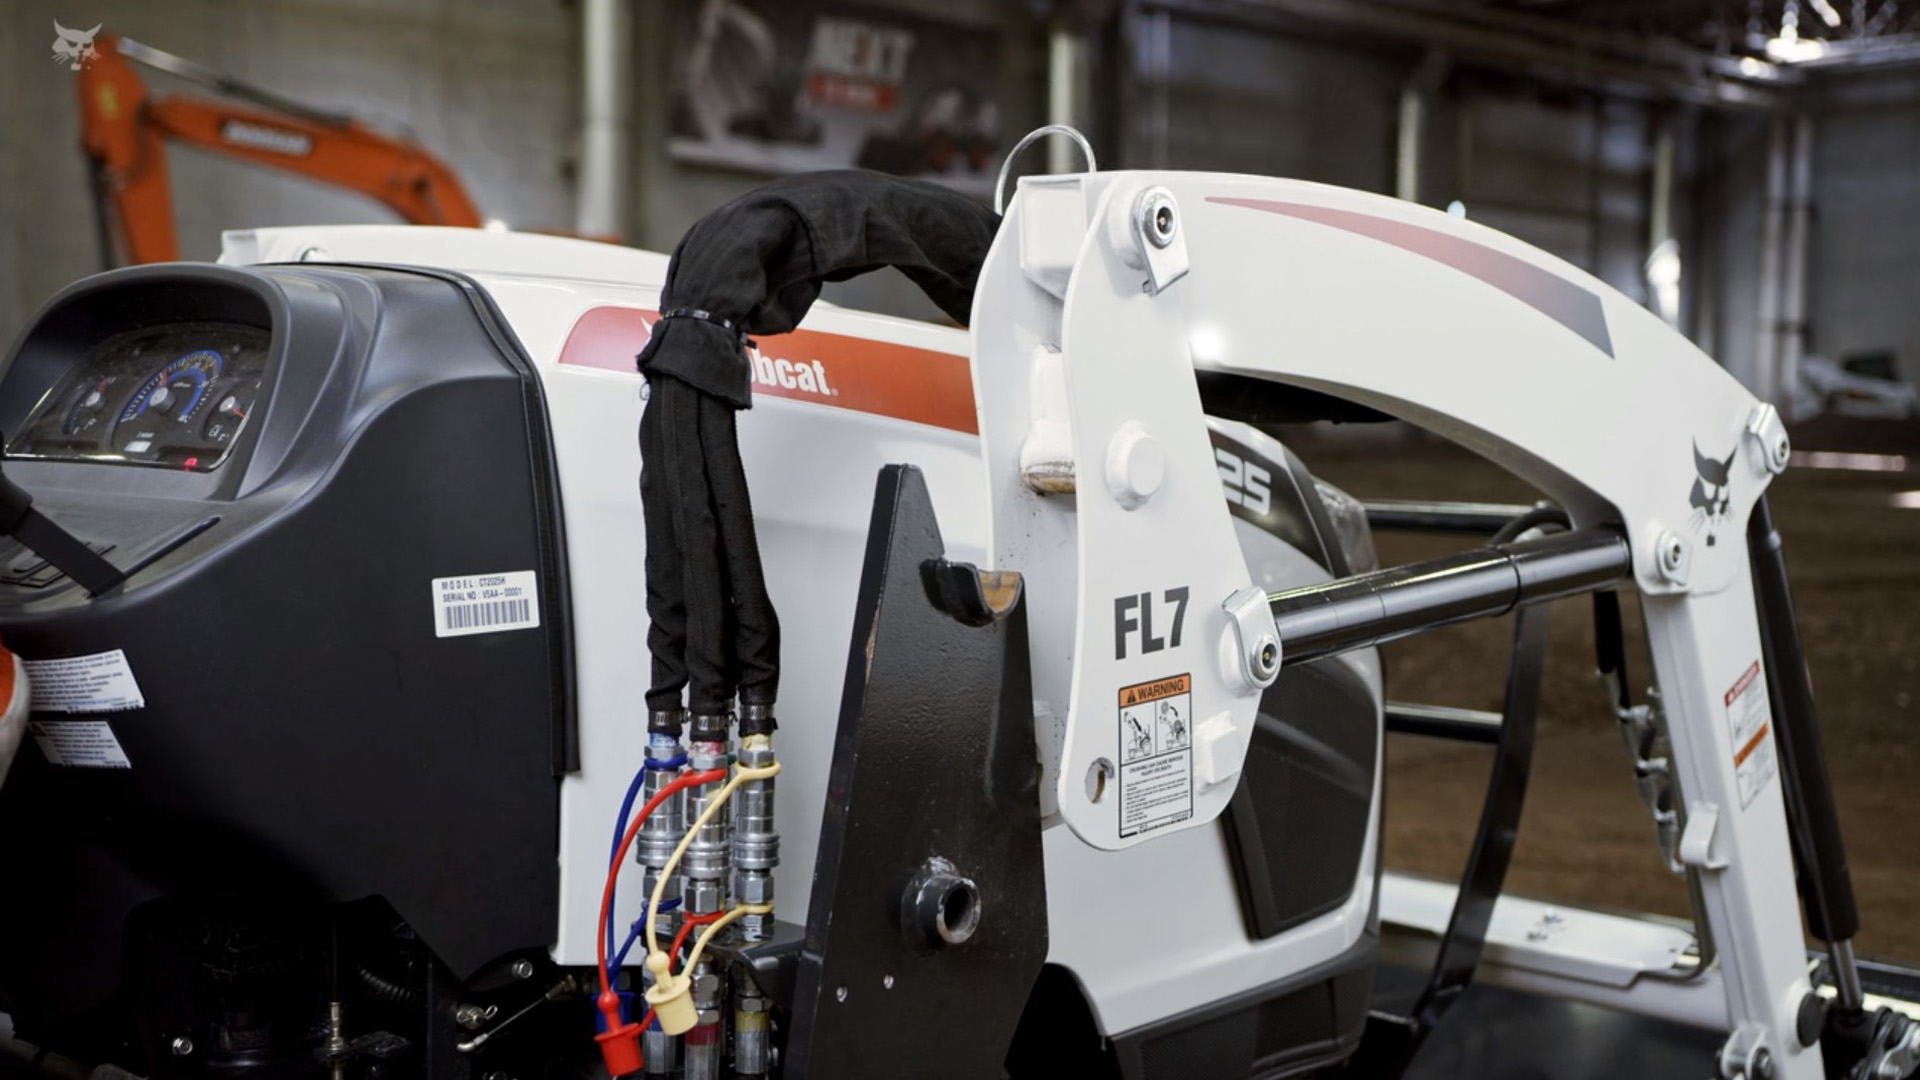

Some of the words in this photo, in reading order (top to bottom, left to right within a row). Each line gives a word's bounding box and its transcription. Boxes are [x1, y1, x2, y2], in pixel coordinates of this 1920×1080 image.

[751, 348, 831, 396] bcat
[1216, 448, 1271, 515] 25
[1114, 586, 1189, 661] FL7
[1138, 679, 1184, 701] WARNING
